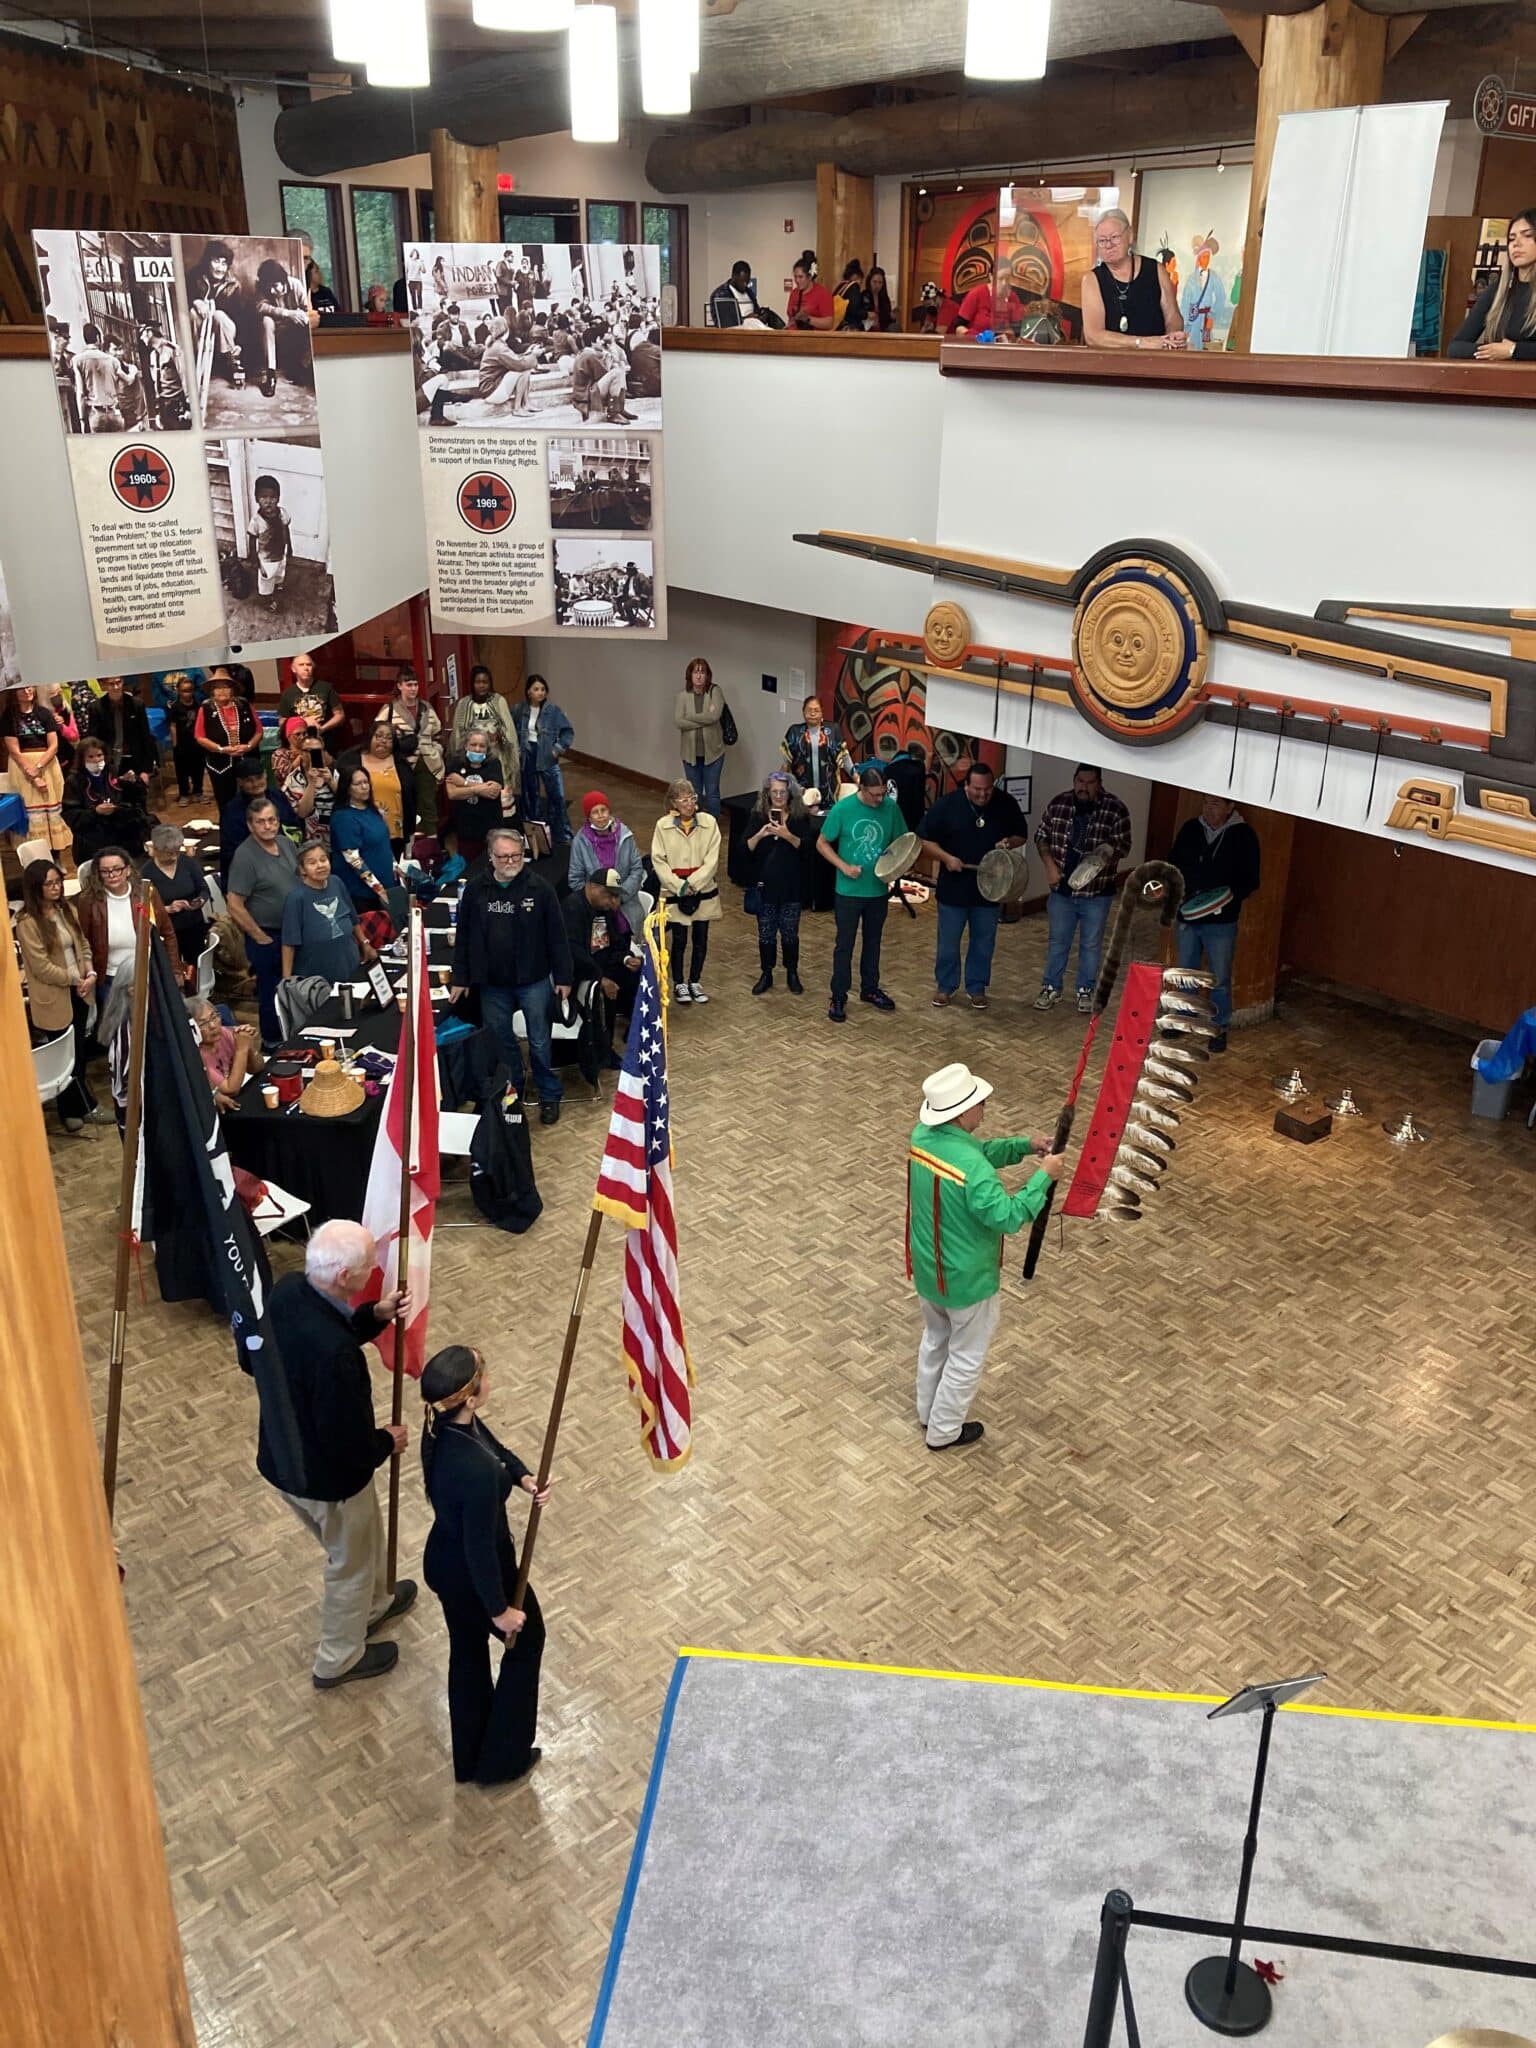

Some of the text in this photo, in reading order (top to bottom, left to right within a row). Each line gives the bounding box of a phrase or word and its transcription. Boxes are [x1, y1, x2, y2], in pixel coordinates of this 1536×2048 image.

[1507, 104, 1536, 128] GIFT
[452, 265, 492, 282] INDIAN
[429, 437, 475, 445] Demonstrators
[481, 448, 505, 456] Olympia
[518, 459, 539, 467] Rights.
[129, 474, 156, 485] 1960s
[477, 499, 497, 508] 1969
[135, 521, 145, 529] the
[148, 519, 178, 528] so-called
[95, 543, 134, 554] government
[160, 539, 191, 547] relocation
[447, 540, 477, 548] November
[97, 554, 128, 564] programs
[466, 560, 479, 568] They
[128, 563, 148, 571] Native
[151, 560, 173, 569] people
[136, 571, 164, 581] liquidate
[166, 569, 184, 577] those
[439, 578, 456, 586] Policy
[101, 585, 132, 593] Promises
[147, 591, 159, 599] and
[161, 588, 200, 598] employment
[487, 596, 498, 604] this
[104, 605, 127, 614] quickly
[130, 602, 166, 612] evaporated
[106, 614, 132, 624] families
[134, 611, 156, 621] arrived
[107, 623, 143, 634] designated
